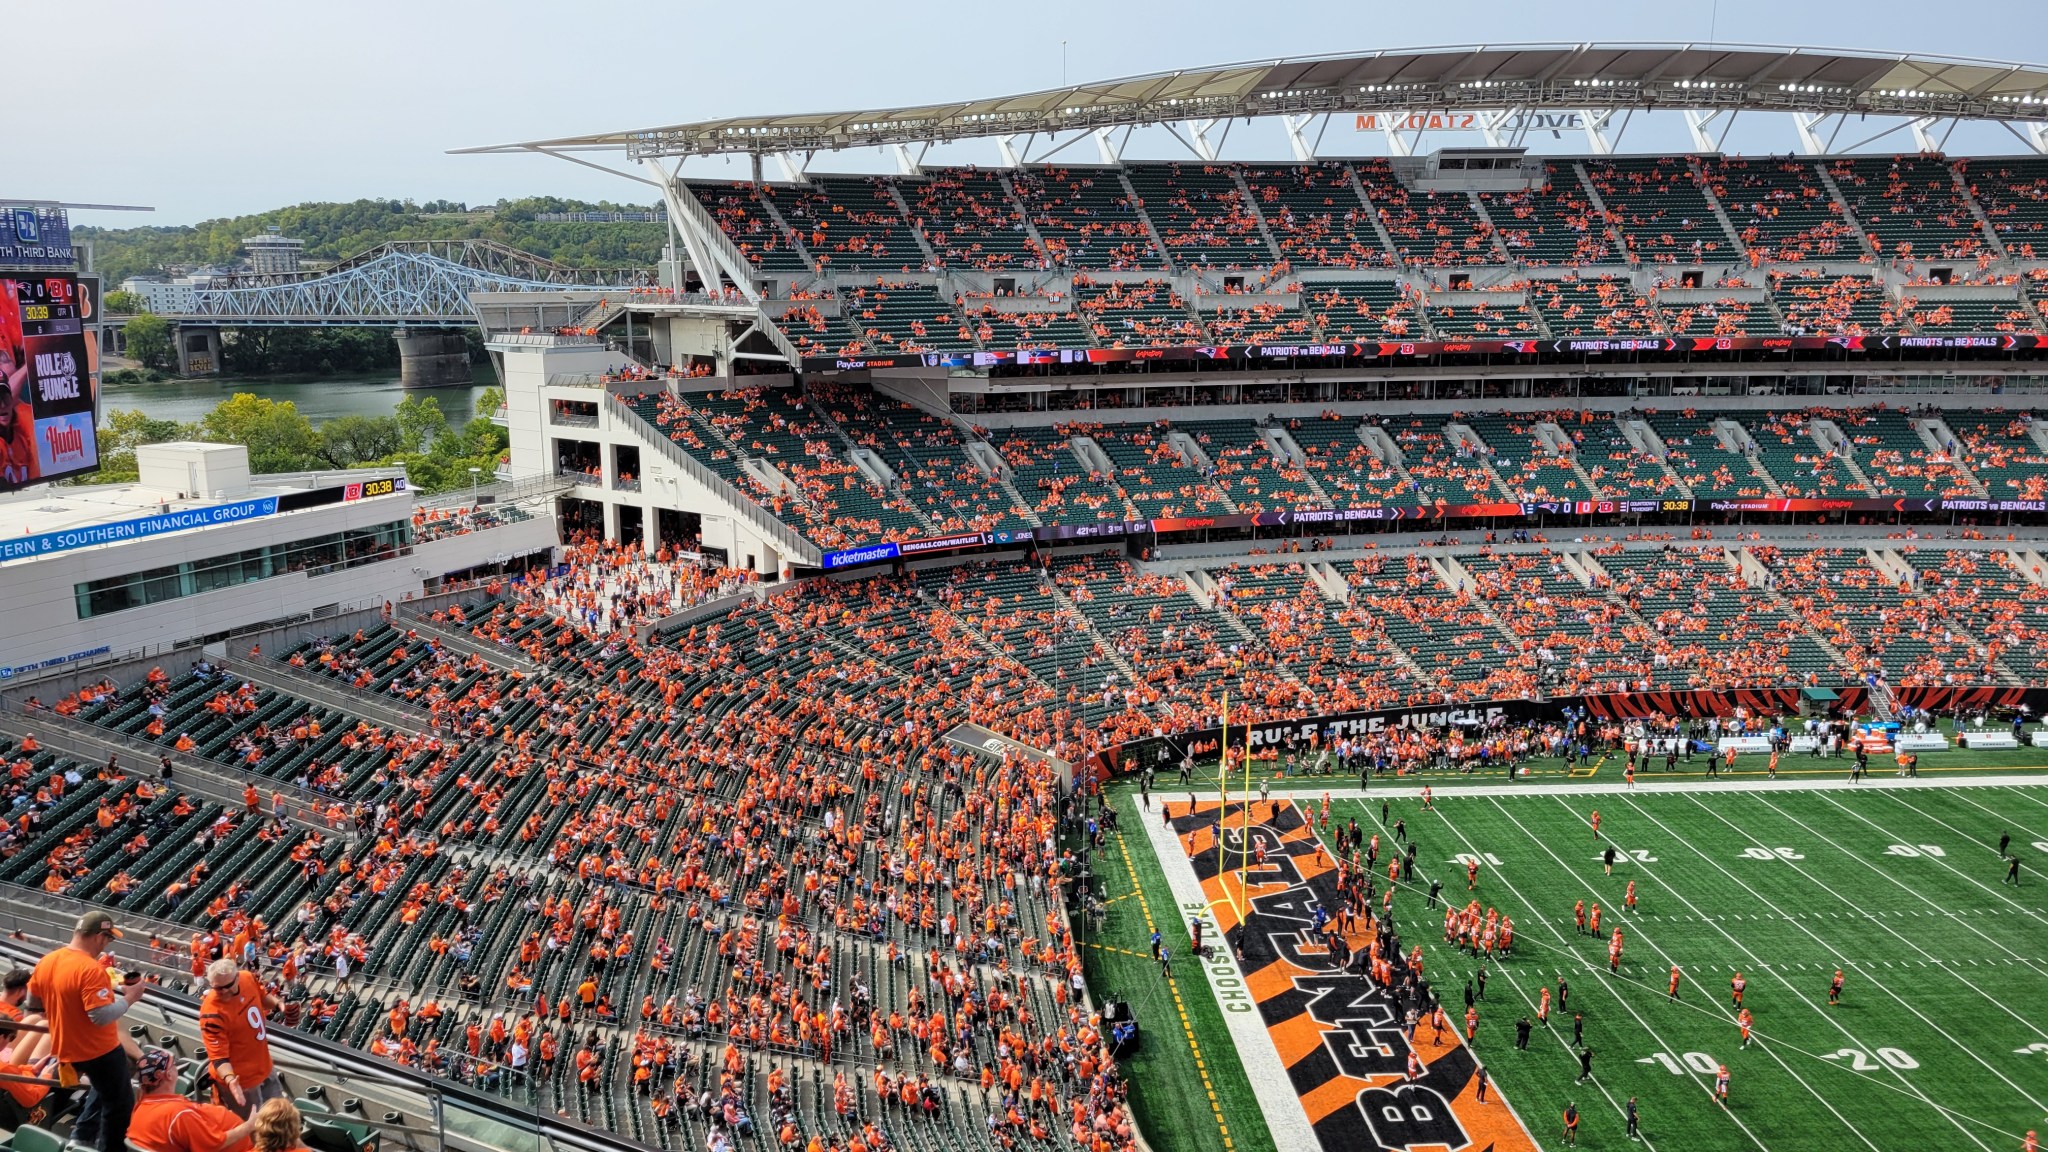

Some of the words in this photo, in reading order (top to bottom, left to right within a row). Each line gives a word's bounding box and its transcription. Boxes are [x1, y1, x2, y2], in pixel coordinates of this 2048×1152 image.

[15, 246, 45, 258] THIRD
[47, 247, 72, 259] BANK
[25, 306, 49, 320] 30:39
[1570, 341, 1609, 350] PATRIOTS
[1621, 340, 1659, 349] BENGALS
[1900, 338, 1942, 347] PATRIOTS
[1955, 337, 1997, 346] BENGALS
[1261, 346, 1299, 356] PATRIOTS
[1309, 346, 1346, 355] BENGALS
[35, 352, 62, 377] RULE
[836, 359, 865, 369] Paycor
[41, 376, 80, 401] JUNGLE
[45, 424, 84, 464] Hudy
[365, 480, 392, 496] 30:38
[395, 478, 405, 489] 40
[1563, 502, 1571, 513] 0
[1582, 502, 1590, 512] 0
[1663, 501, 1688, 510] 30:38
[1711, 502, 1738, 510] Paycor
[1941, 500, 1987, 510] PATRIOTS
[2000, 501, 2046, 511] BENGALS
[1293, 511, 1334, 522] PATRIOTS
[1344, 509, 1383, 519] BENGALS
[42, 538, 52, 550] &
[57, 524, 135, 548] SOUTHERN
[140, 512, 209, 533] FINANCIAL
[213, 504, 255, 520] GROUP
[1076, 526, 1088, 535] 421
[902, 536, 978, 551] BENGALS.COM/WAITLIST
[832, 547, 890, 566] ticketmaster
[14, 664, 38, 673] FIFTH
[40, 657, 65, 668] THIRD
[68, 645, 110, 661] EXCHANGE
[247, 1006, 266, 1041] 9
[1652, 1052, 1721, 1075] 10
[1837, 1047, 1920, 1071] 20
